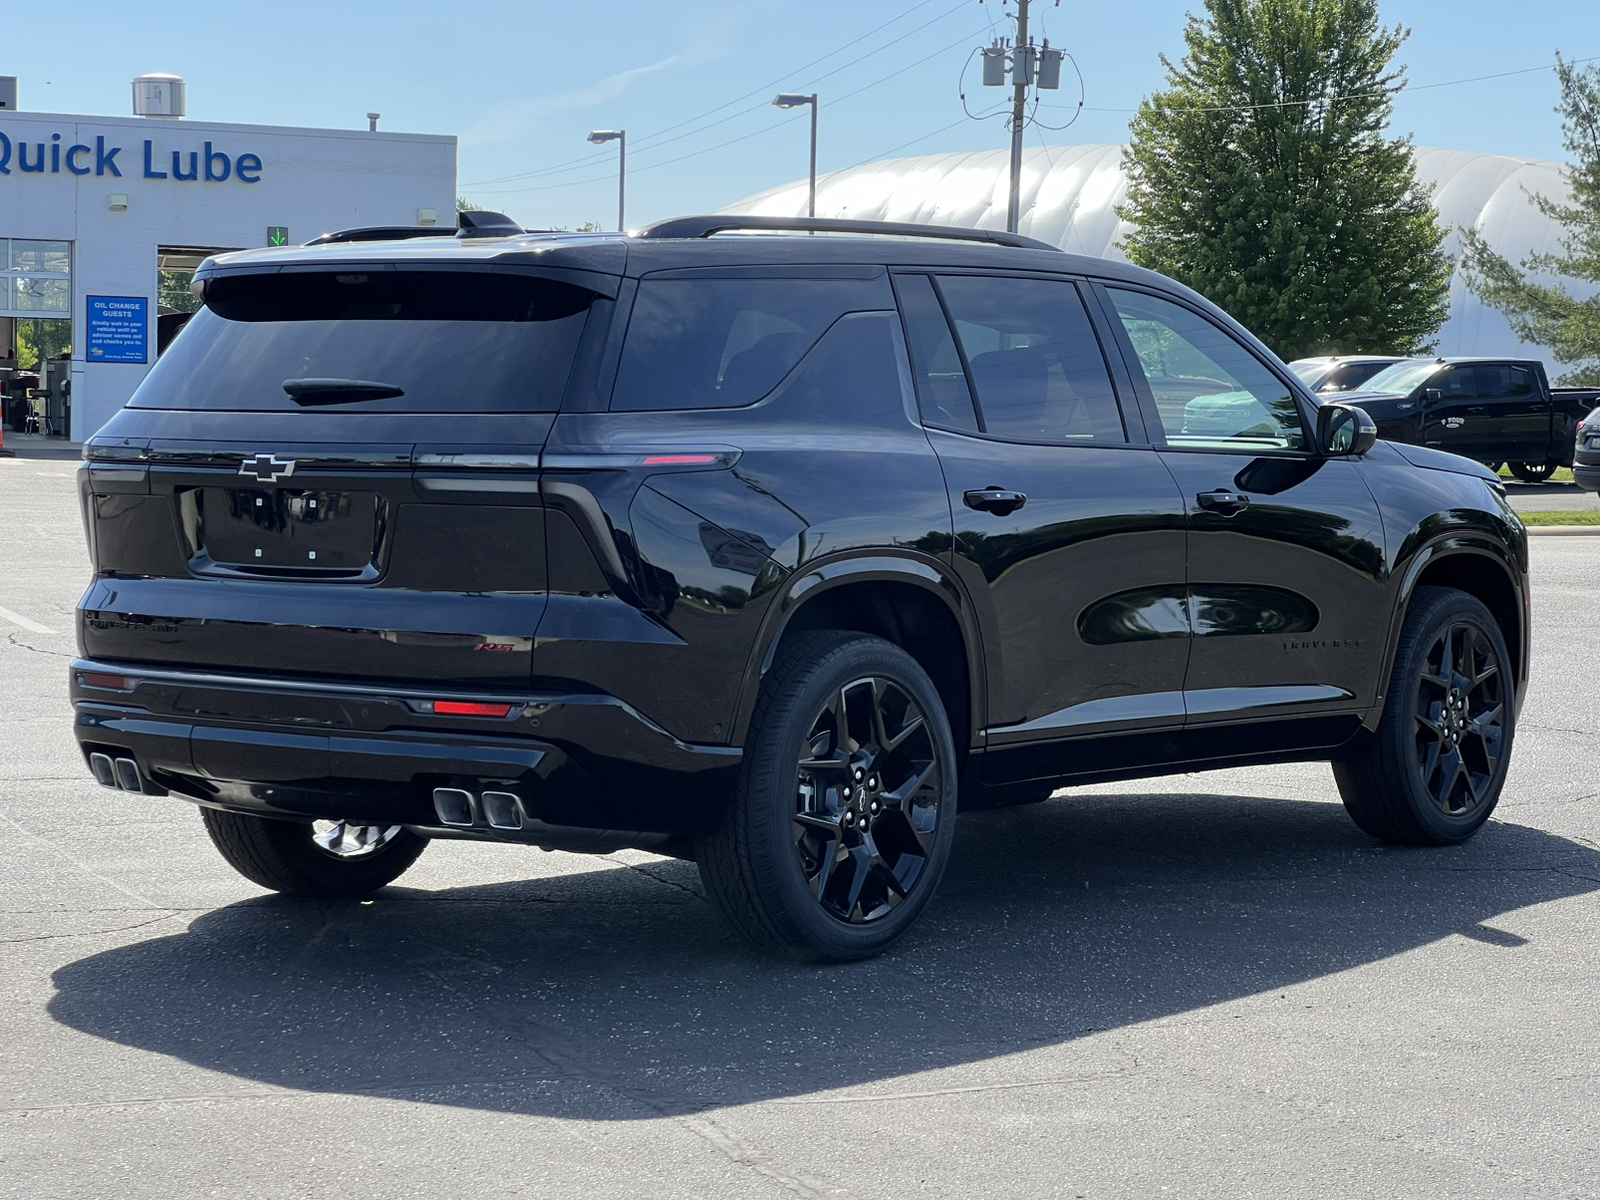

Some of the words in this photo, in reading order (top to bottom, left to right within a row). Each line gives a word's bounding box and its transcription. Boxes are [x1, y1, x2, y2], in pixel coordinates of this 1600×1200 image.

[144, 140, 262, 183] Lube
[474, 643, 515, 653] RS
[1282, 639, 1364, 650] TRAVERSE
